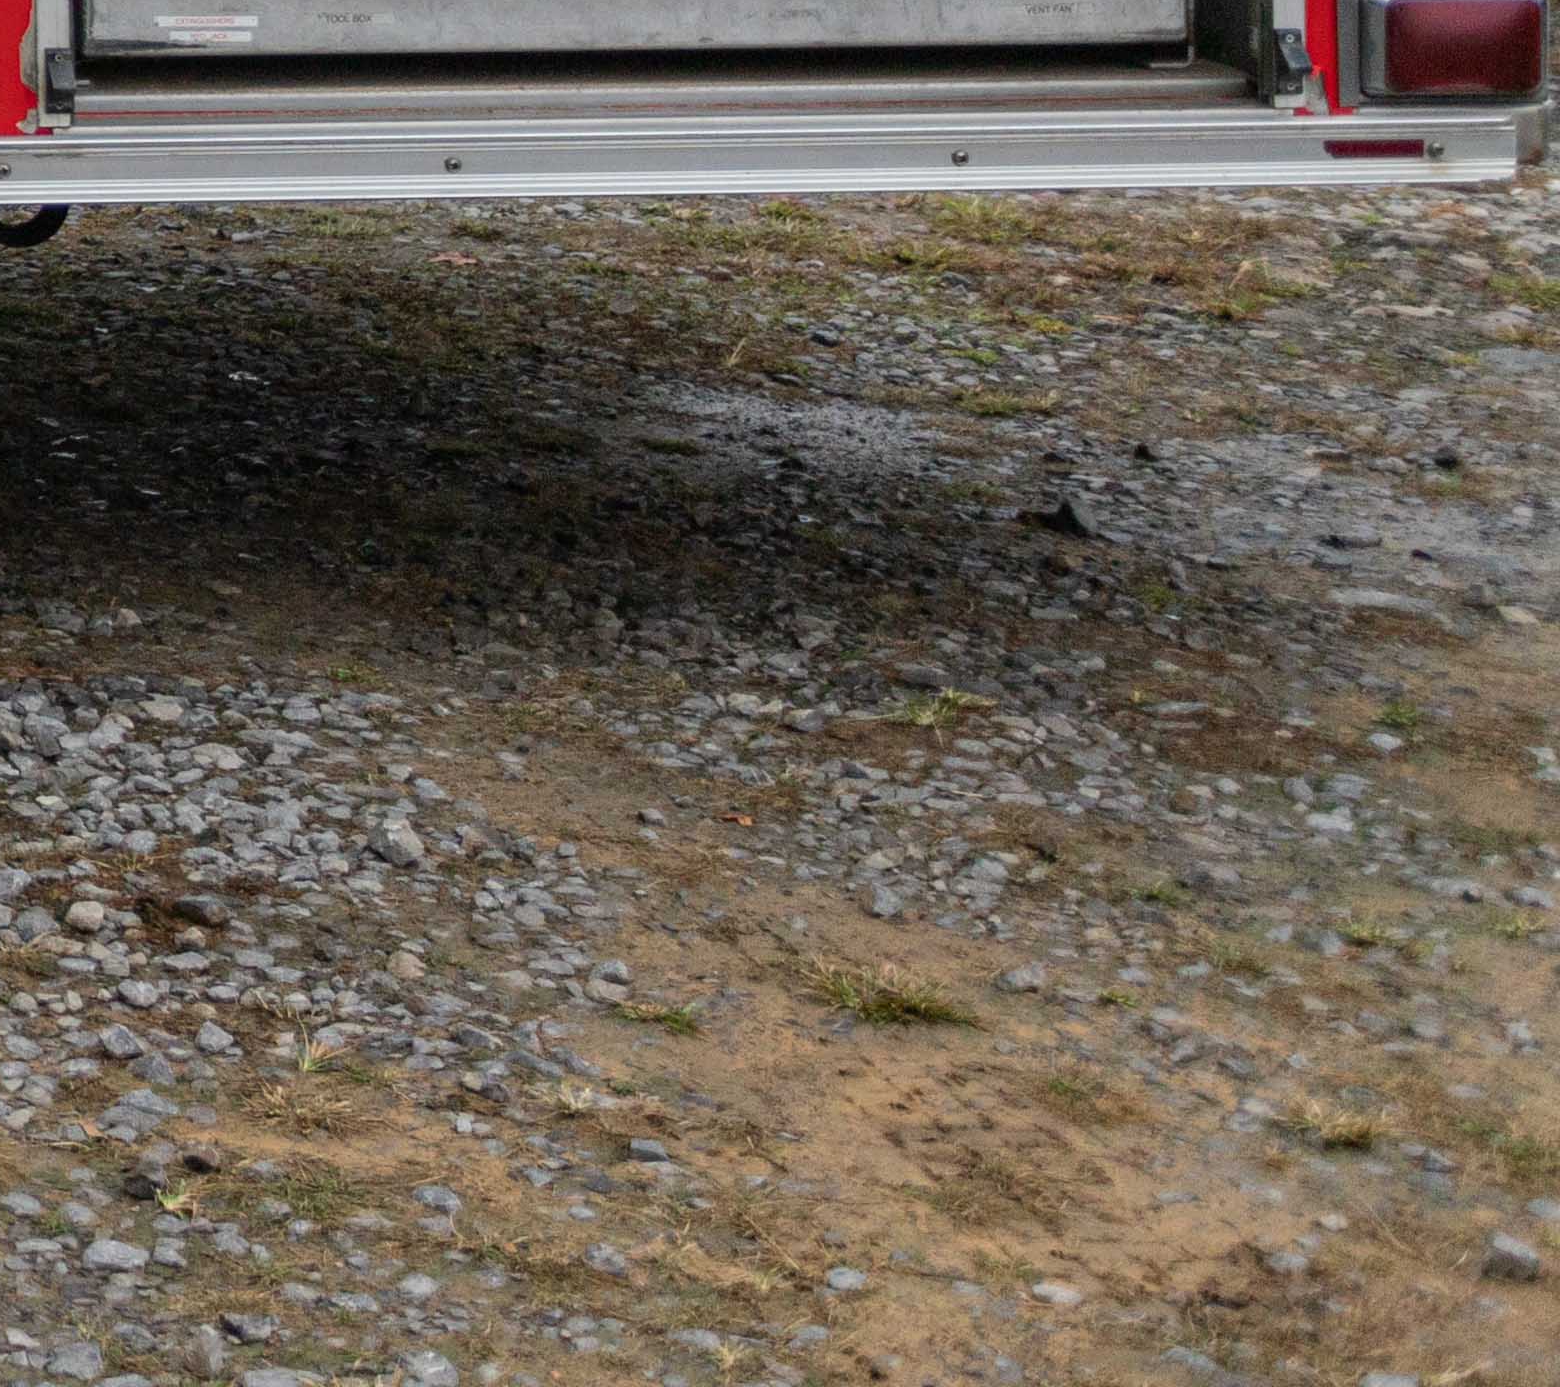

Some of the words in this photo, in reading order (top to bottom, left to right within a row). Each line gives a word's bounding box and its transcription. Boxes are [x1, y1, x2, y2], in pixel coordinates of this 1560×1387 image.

[1025, 5, 1051, 15] VENT
[1052, 4, 1072, 13] FAN
[325, 12, 351, 24] TOOL
[352, 12, 372, 23] BOX
